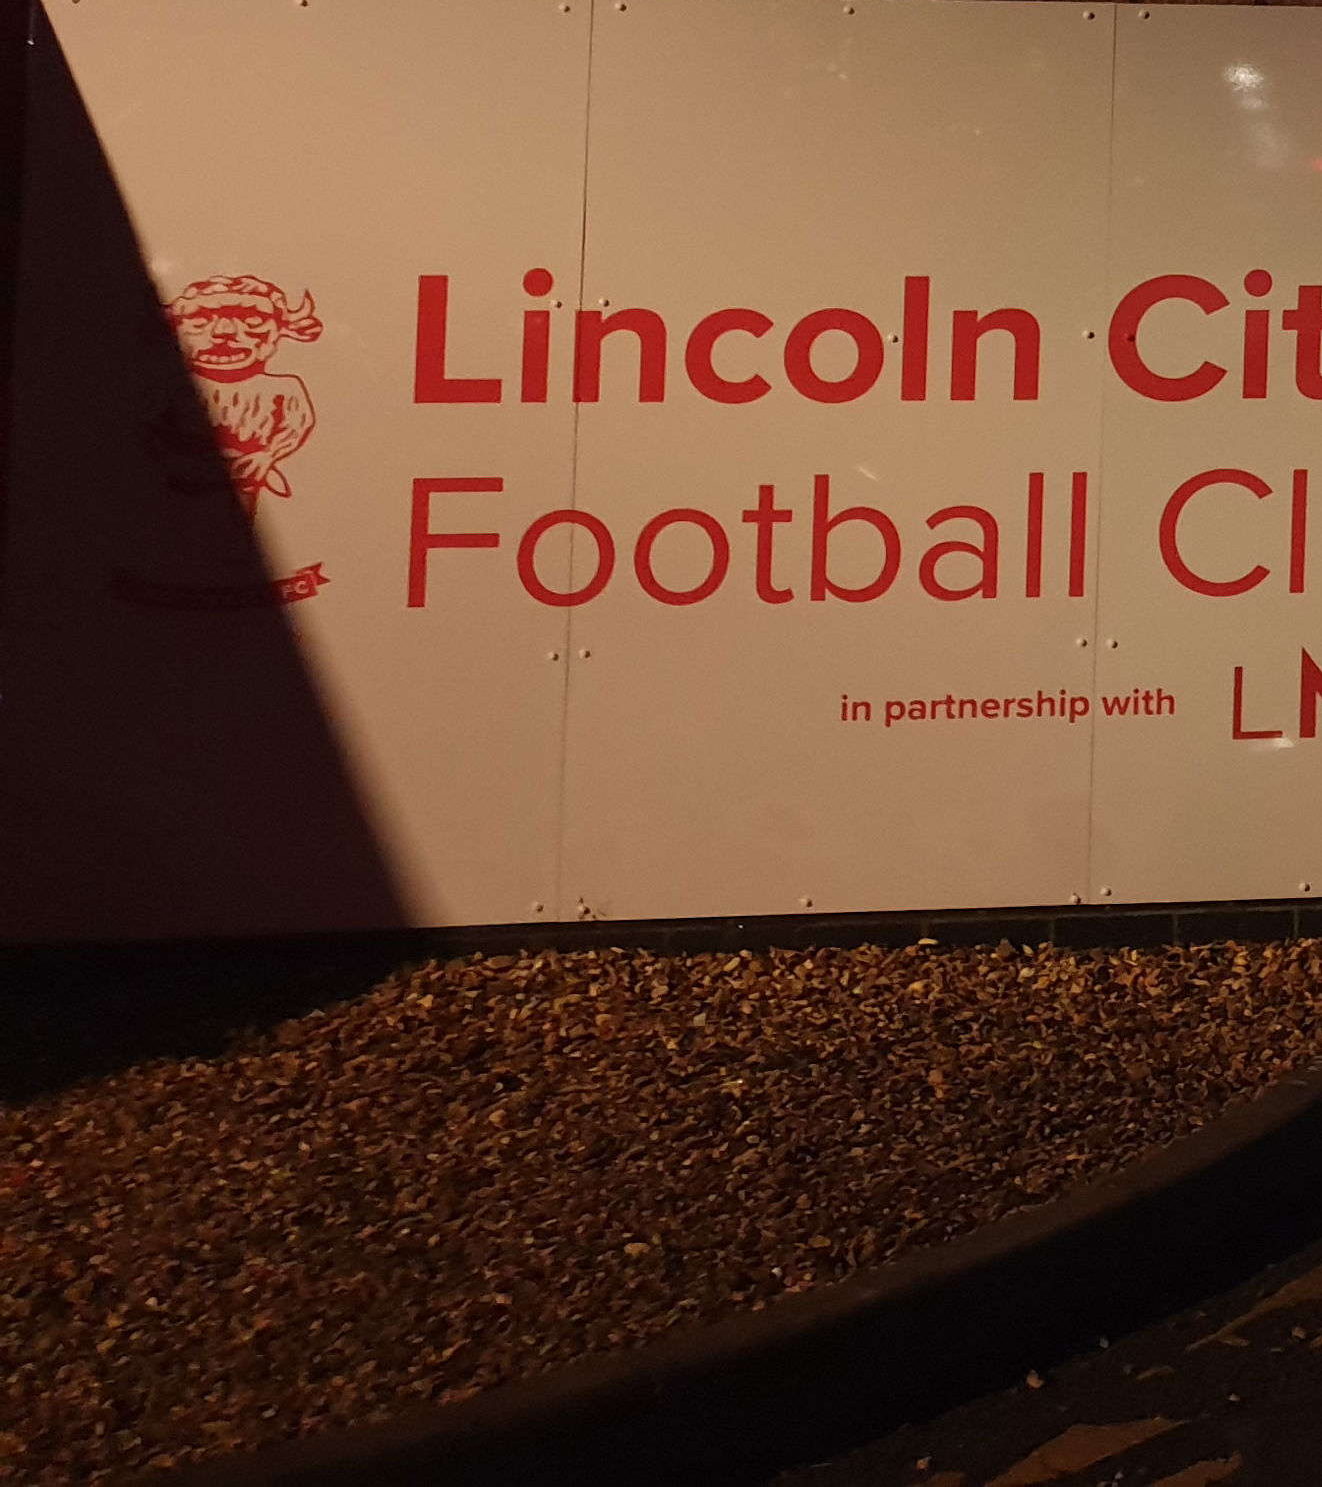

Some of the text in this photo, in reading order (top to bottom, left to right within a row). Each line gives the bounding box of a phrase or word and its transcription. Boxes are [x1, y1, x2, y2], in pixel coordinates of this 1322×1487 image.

[413, 268, 1041, 405] Lincoln
[408, 472, 1089, 609] Football
[841, 694, 872, 722] in
[885, 689, 1091, 728] partnership
[1102, 688, 1177, 717] with
